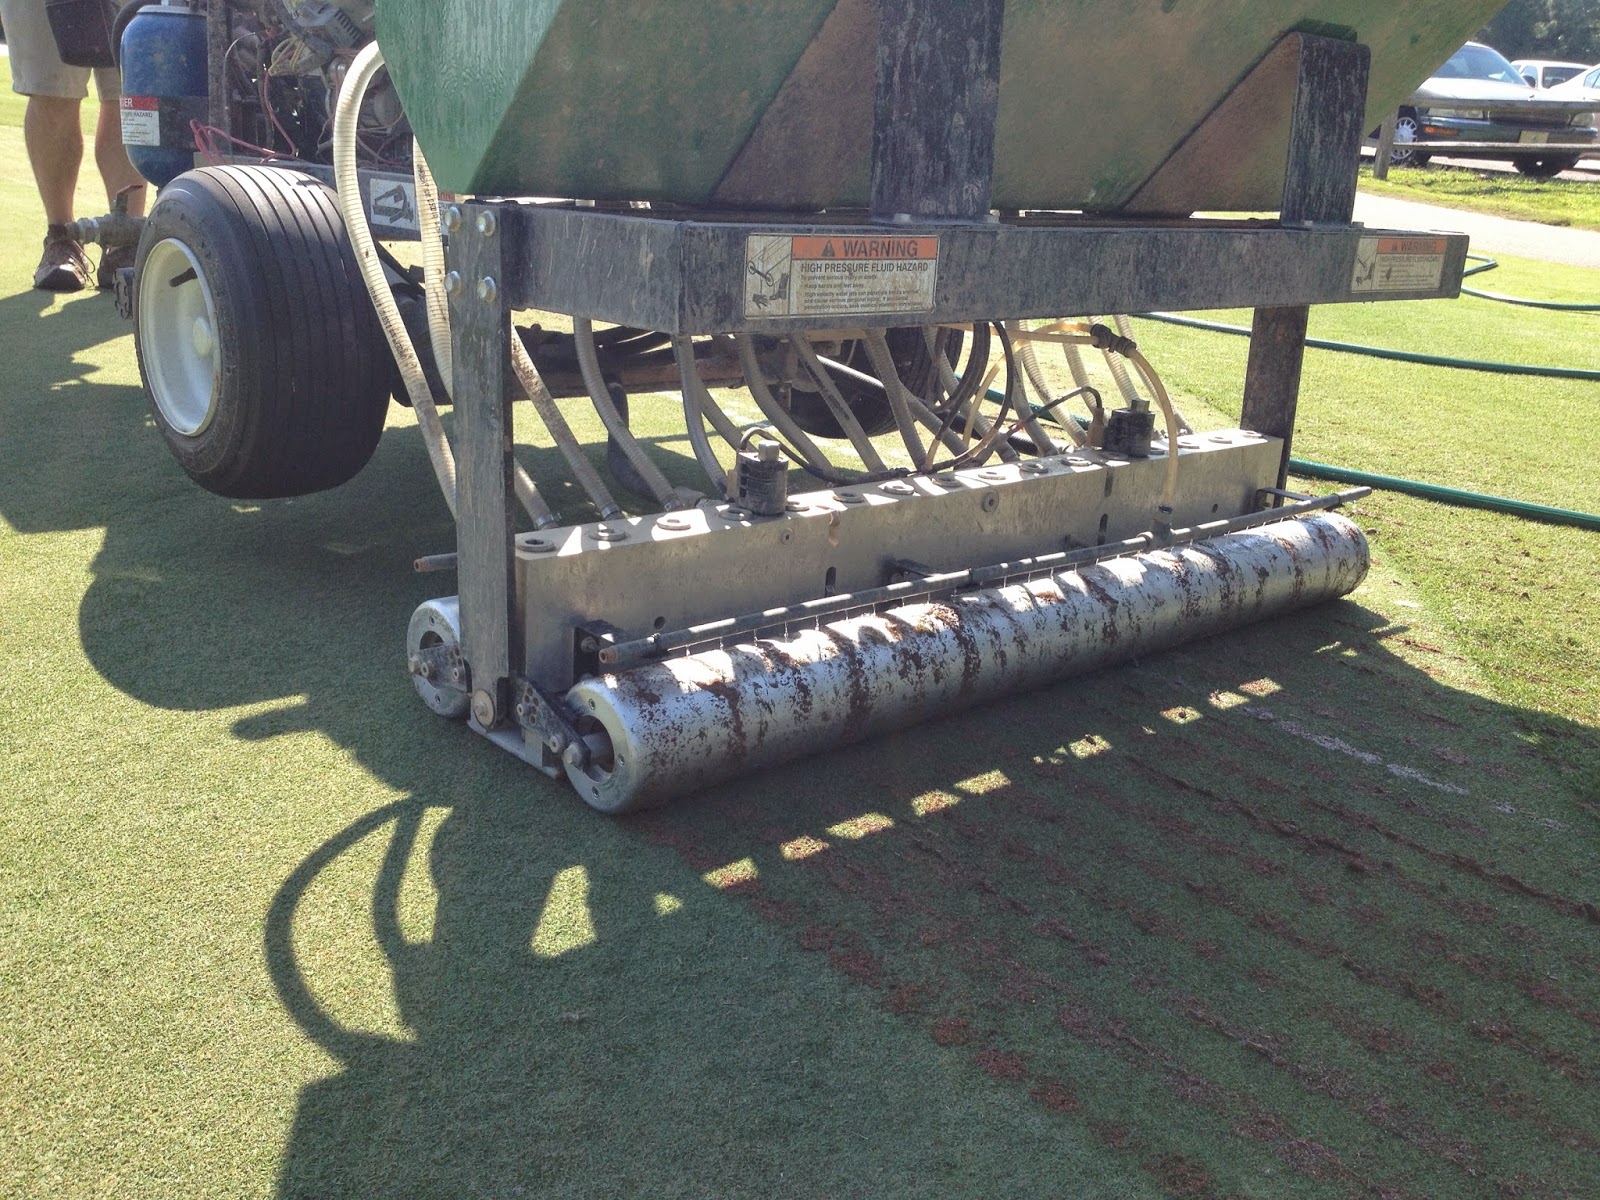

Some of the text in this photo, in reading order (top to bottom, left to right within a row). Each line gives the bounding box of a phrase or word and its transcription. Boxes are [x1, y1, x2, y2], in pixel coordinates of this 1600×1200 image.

[843, 240, 918, 258] WARNING
[1402, 240, 1437, 252] WARNING
[800, 262, 928, 272] HIGH PRESSURE FLUID HAZARD
